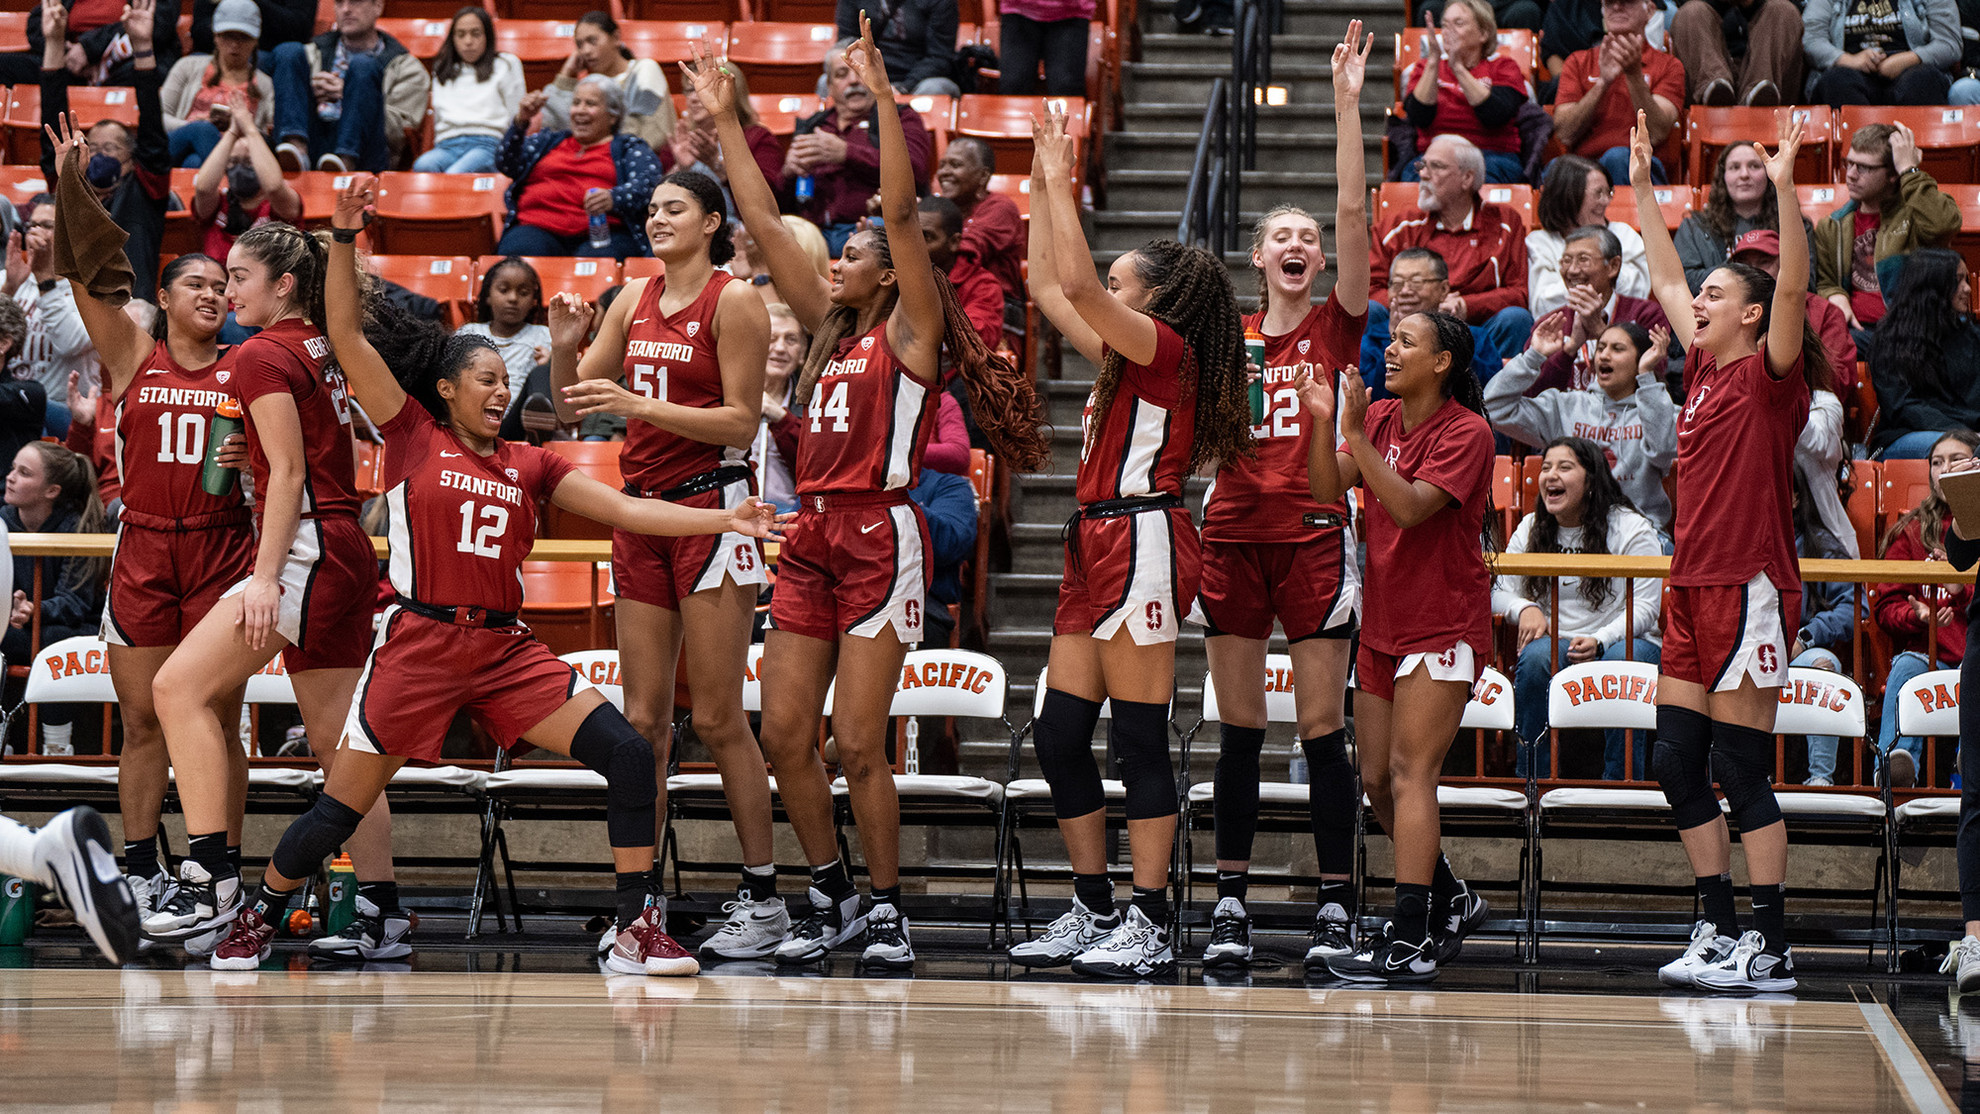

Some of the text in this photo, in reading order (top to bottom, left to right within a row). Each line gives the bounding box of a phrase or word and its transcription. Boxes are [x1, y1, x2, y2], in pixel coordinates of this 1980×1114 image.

[628, 340, 694, 363] STANFORD
[634, 363, 668, 402] 51
[820, 358, 867, 378] NFORD
[138, 387, 229, 408] STANFORD
[808, 382, 850, 433] 44
[157, 411, 206, 465] 10
[1572, 422, 1643, 442] STANFORD
[440, 470, 523, 507] STANFORD
[457, 500, 510, 560] 12
[46, 650, 110, 680] PACI
[895, 662, 993, 694] ACIFIC
[1562, 675, 1656, 707] PACIFI
[1778, 679, 1852, 713] CIFIC
